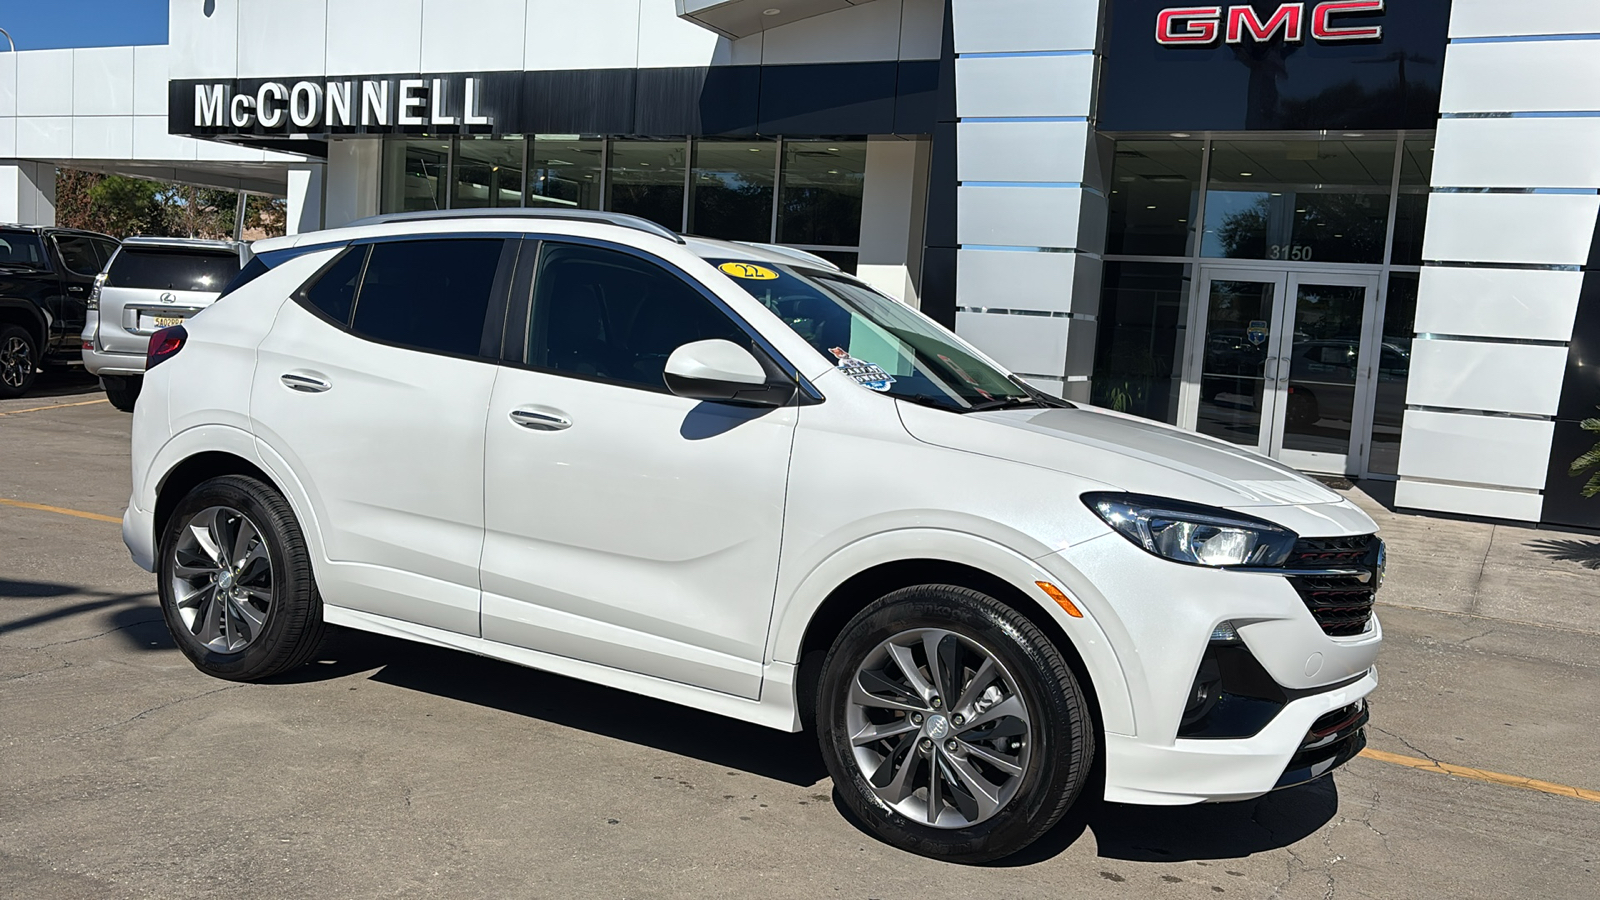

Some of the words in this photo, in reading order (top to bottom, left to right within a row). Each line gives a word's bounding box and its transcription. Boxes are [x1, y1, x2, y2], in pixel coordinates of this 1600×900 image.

[1155, 0, 1384, 44] GMC
[194, 78, 490, 128] McCONNELL
[1269, 244, 1313, 261] 3150
[735, 264, 765, 278] 22
